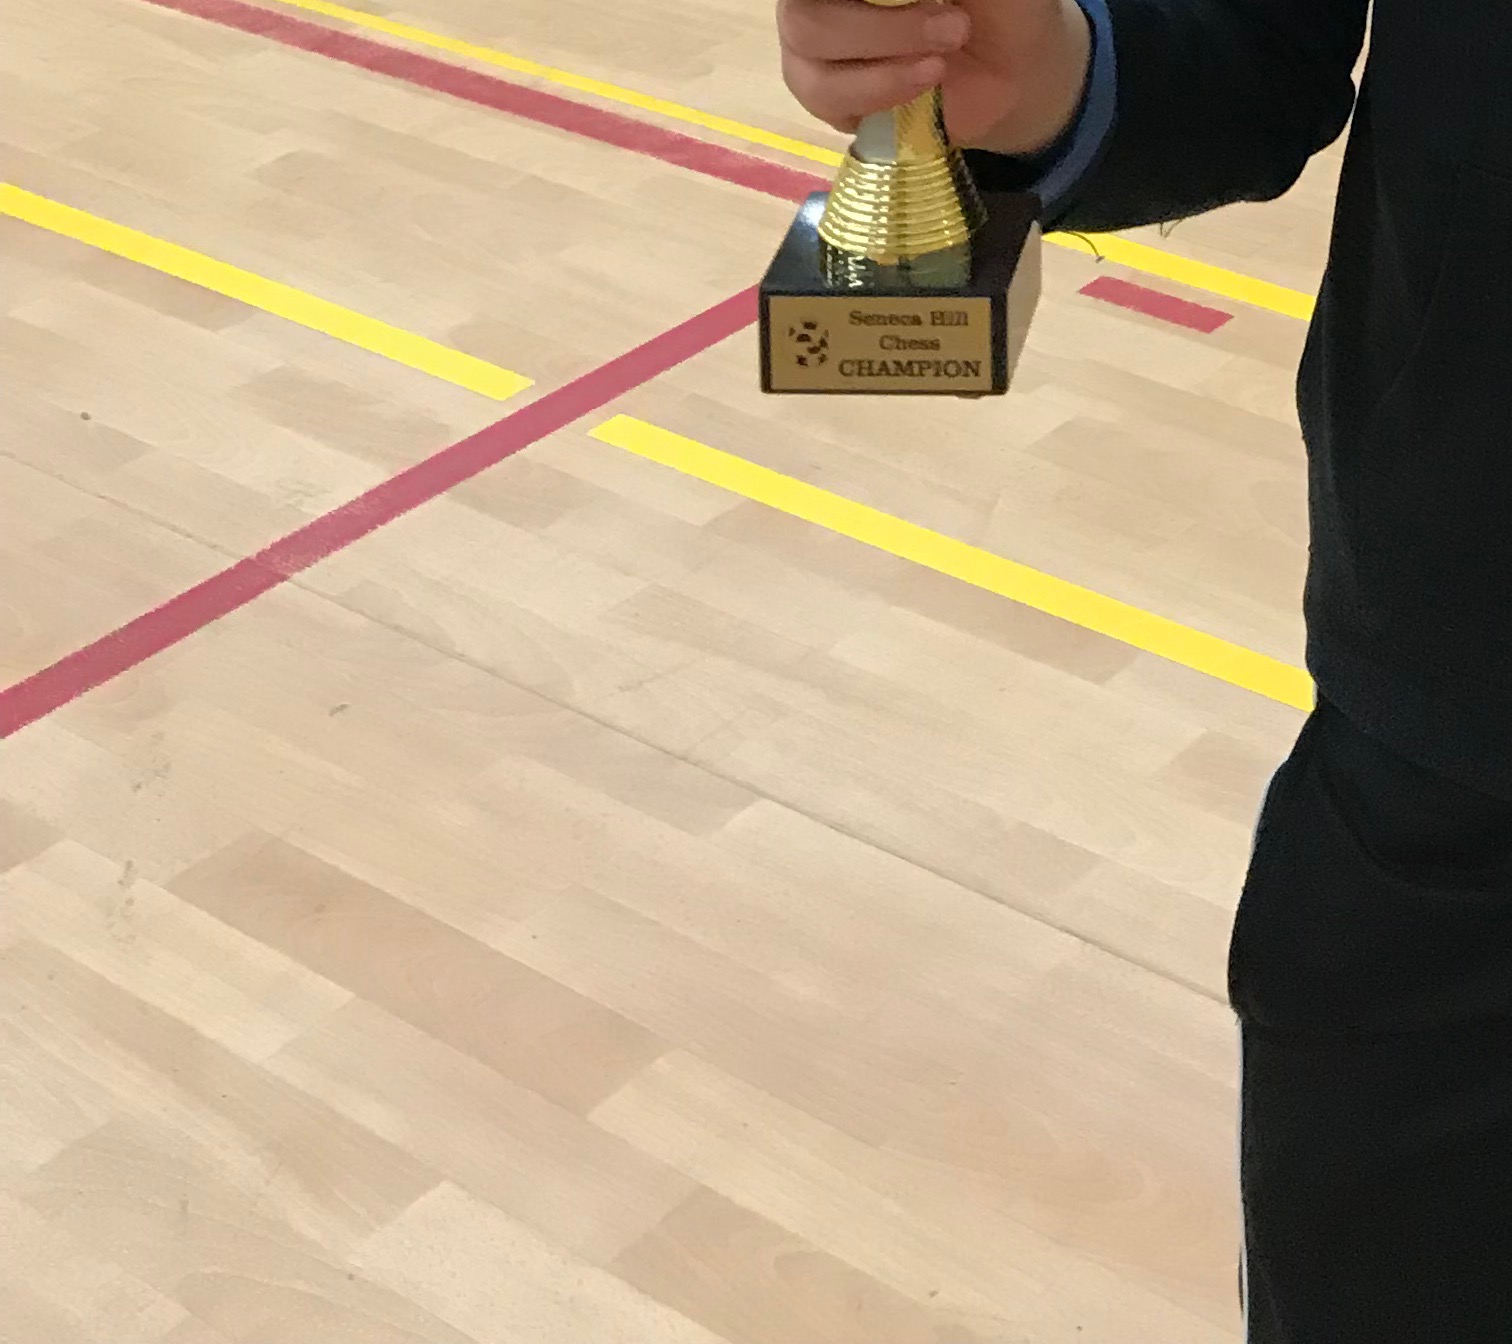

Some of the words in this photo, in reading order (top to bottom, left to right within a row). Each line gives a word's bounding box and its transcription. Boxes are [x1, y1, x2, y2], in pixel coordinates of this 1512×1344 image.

[848, 309, 922, 327] Seneca
[930, 310, 969, 326] Hill
[879, 335, 941, 351] Chess
[838, 359, 982, 379] CHAMPION
